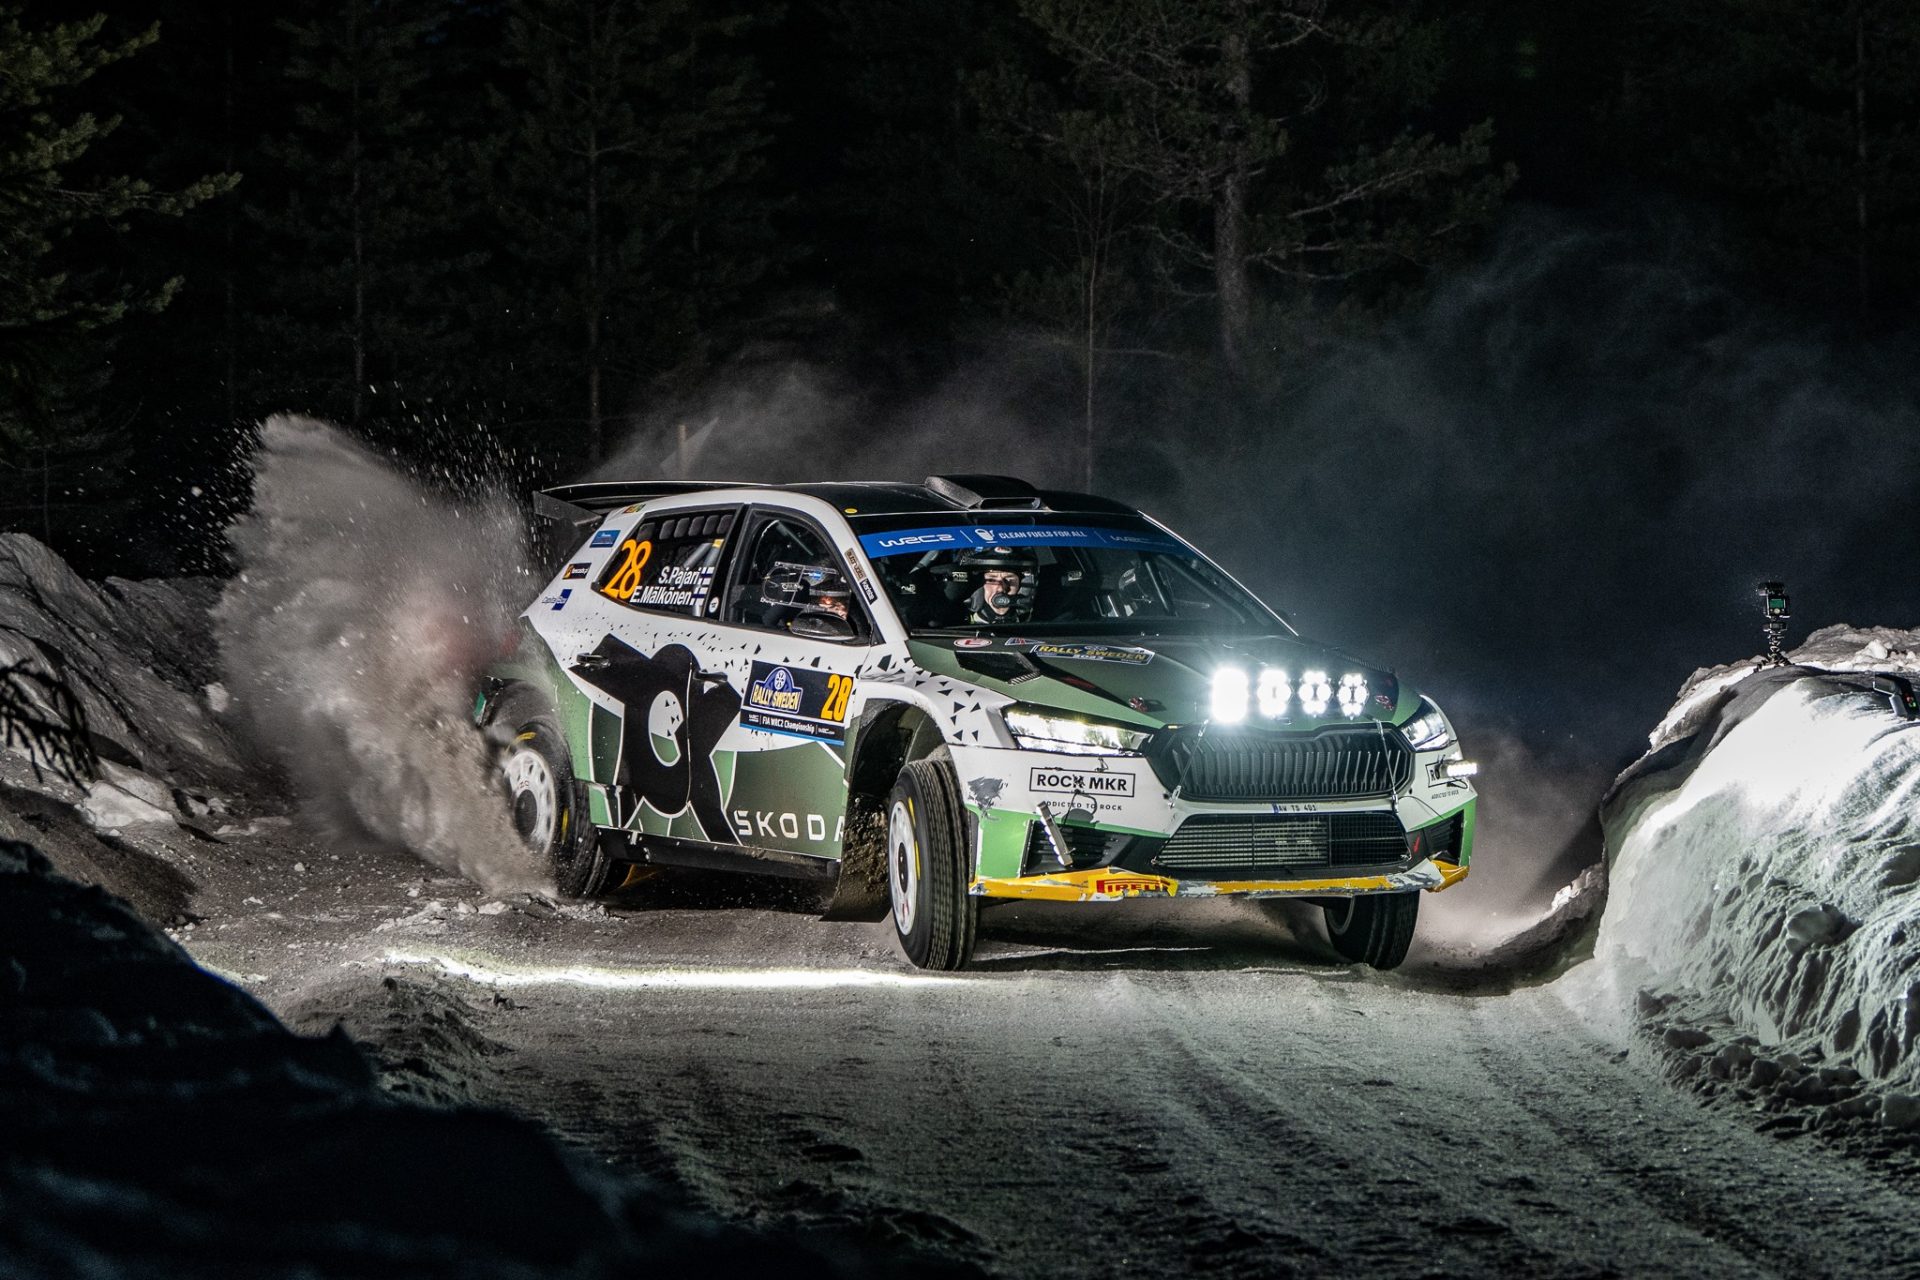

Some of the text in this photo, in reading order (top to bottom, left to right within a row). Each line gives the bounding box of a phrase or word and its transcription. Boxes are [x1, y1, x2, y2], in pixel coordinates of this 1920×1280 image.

[879, 533, 955, 548] WRC2
[998, 531, 1027, 539] CLEAN
[1053, 530, 1072, 538] FOR
[1072, 530, 1088, 538] ALL
[601, 539, 652, 599] 28
[658, 566, 701, 589] S.Pajari
[629, 585, 693, 606] E.Mälkönen
[1038, 645, 1082, 655] RALLY
[1086, 650, 1147, 660] SWEDEN
[752, 684, 801, 711] RALLY SWEDEN
[820, 673, 853, 722] 28
[762, 716, 771, 725] FIA
[1036, 774, 1128, 791] ROCK MKR
[1045, 801, 1082, 809] DDICTED
